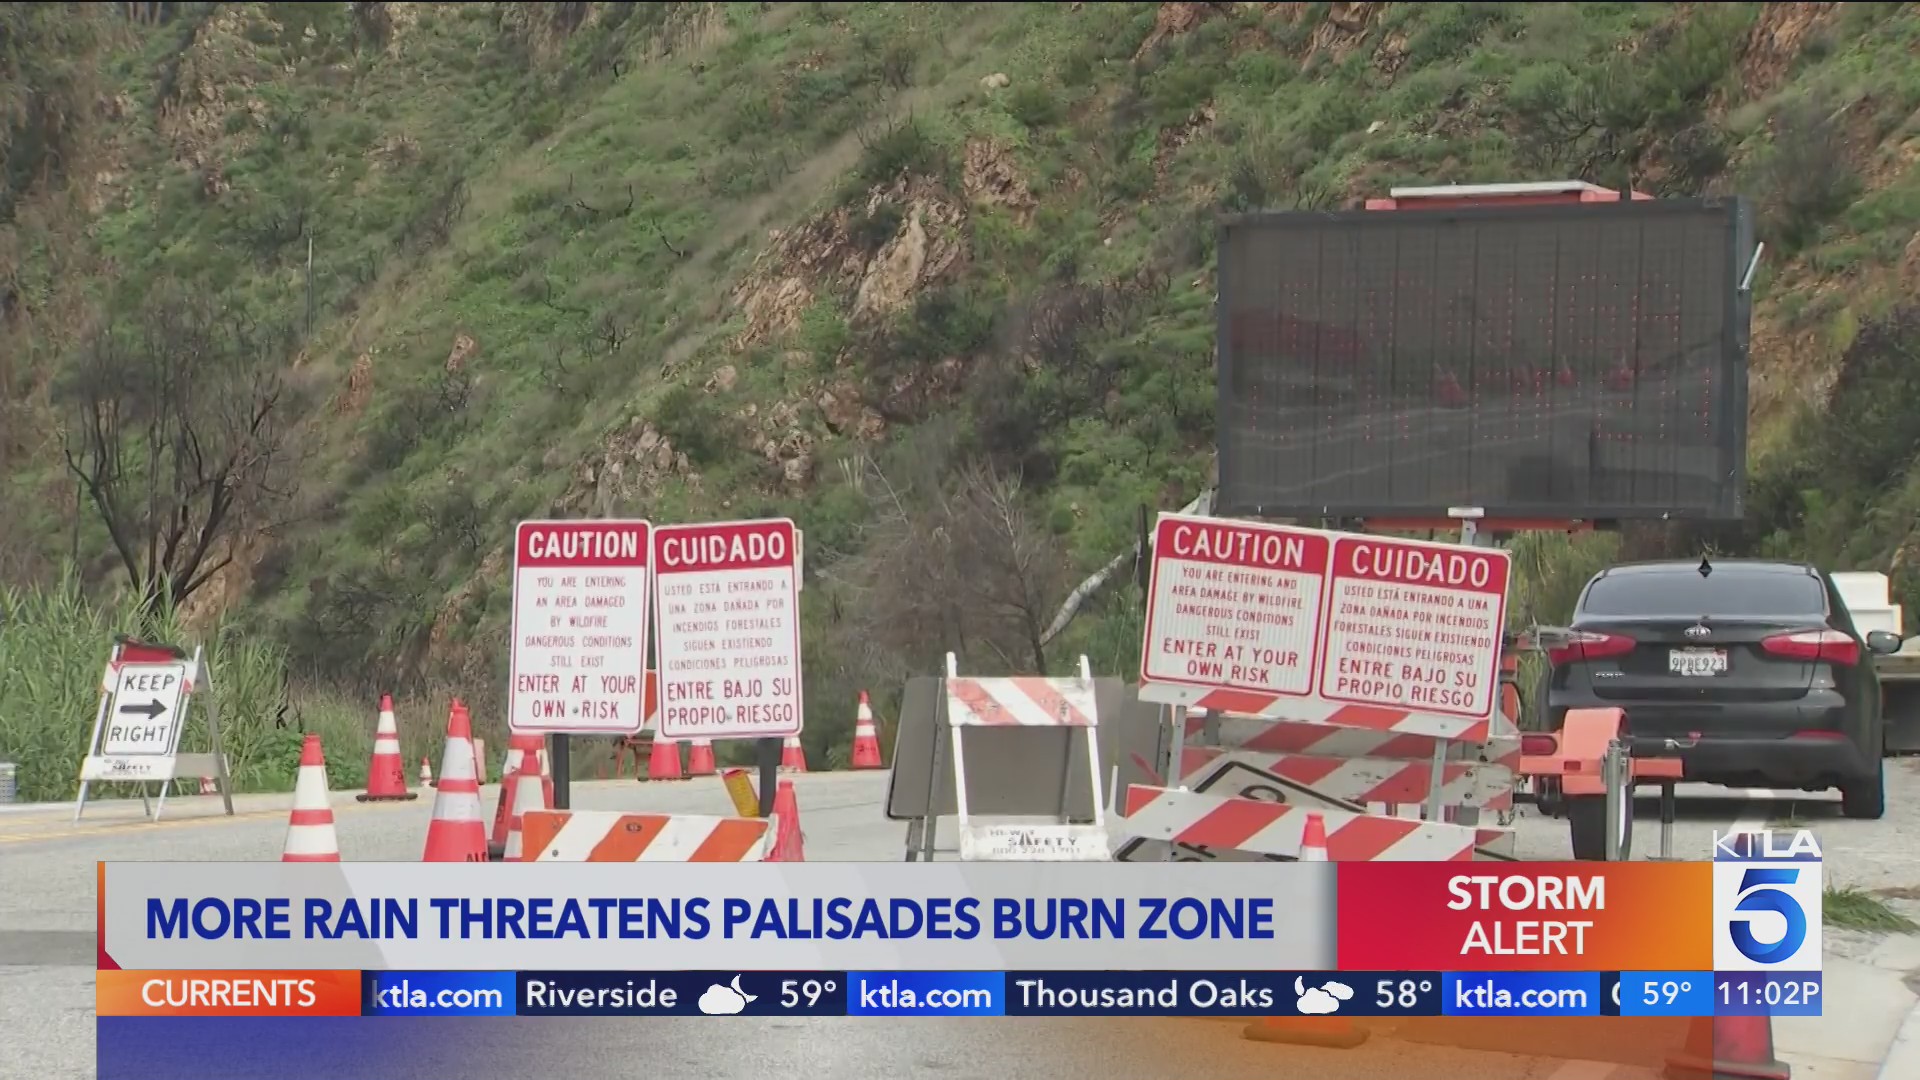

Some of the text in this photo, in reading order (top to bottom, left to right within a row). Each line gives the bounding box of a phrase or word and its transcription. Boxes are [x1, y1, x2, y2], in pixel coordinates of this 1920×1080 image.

[529, 531, 637, 559] CAUTION
[663, 531, 785, 566] CUIDADO
[1173, 525, 1304, 568] CAUTION
[1352, 545, 1490, 588] CUIDADO
[537, 576, 626, 588] YOU ARE ENTERING
[664, 583, 692, 596] USTED
[728, 580, 773, 593] ENTRANDO
[781, 579, 788, 590] A
[1183, 567, 1297, 590] YOU ARE ENTERING AND
[536, 596, 625, 608] AN AREA DAMAGED
[669, 603, 686, 615] UNA
[694, 602, 716, 614] ZONA
[766, 598, 784, 610] POR
[1172, 586, 1303, 610] AREA DAMAGE BY WILDFIRE
[1344, 586, 1374, 598] USTED
[1404, 591, 1454, 608] ENTRANDO
[1457, 597, 1464, 608] A
[1468, 599, 1488, 611] UNA
[550, 616, 608, 628] BY WILDFIRE
[673, 618, 782, 633] INCENDIOS FORESTALES
[1176, 604, 1294, 626] DANGEROUS CONDITIONS
[1340, 603, 1365, 616] ZONA
[1413, 612, 1432, 622] POR
[1436, 613, 1489, 630] INCENDIOS
[525, 635, 633, 648] DANGEROUS CONDITIONS
[1206, 626, 1260, 641] STILL EXIST
[1334, 620, 1490, 648] FORESTALES SIGUEN EXISTIENDO
[684, 638, 772, 652] SIGUEN EXISTIENDO
[1163, 638, 1298, 667] ENTER AT YOUR
[1346, 641, 1474, 666] CONDICIONES PELIGROSAS
[551, 655, 604, 668] STILL EXIST
[669, 656, 788, 671] CONDICIONES PELIGROSAS
[1187, 660, 1270, 683] OWN RISK
[124, 674, 176, 692] KEEP
[518, 674, 636, 694] ENTER AT YOUR
[1340, 658, 1477, 688] ENTRE BAJO SU
[668, 678, 792, 701] ENTRE BAJO SU
[1337, 677, 1474, 708] PROPIO RIESGO
[532, 700, 619, 719] OWN RISK
[668, 703, 792, 726] PROPIO RIESGO
[110, 725, 168, 742] RIGHT
